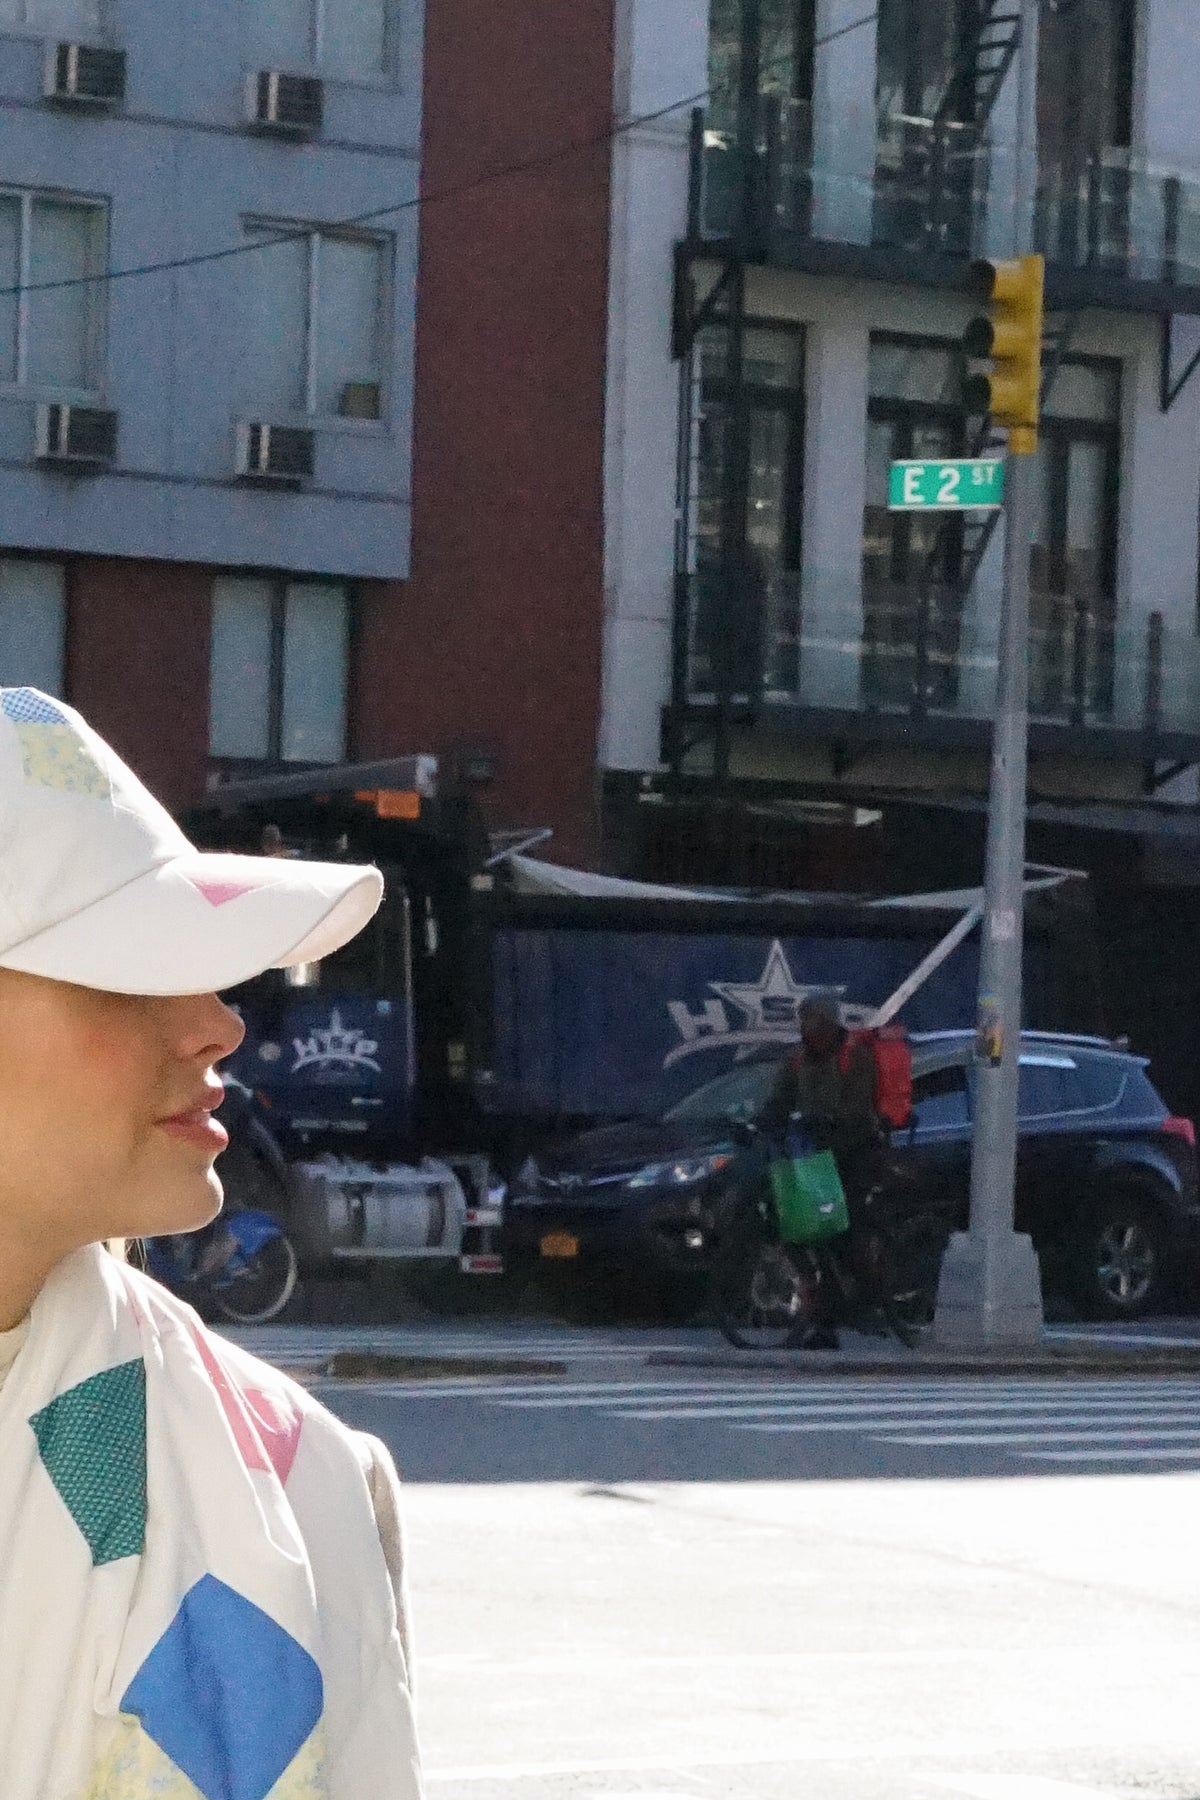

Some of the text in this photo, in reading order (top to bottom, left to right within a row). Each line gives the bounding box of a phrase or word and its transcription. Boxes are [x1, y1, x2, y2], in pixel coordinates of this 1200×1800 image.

[904, 465, 994, 502] E 2 ST
